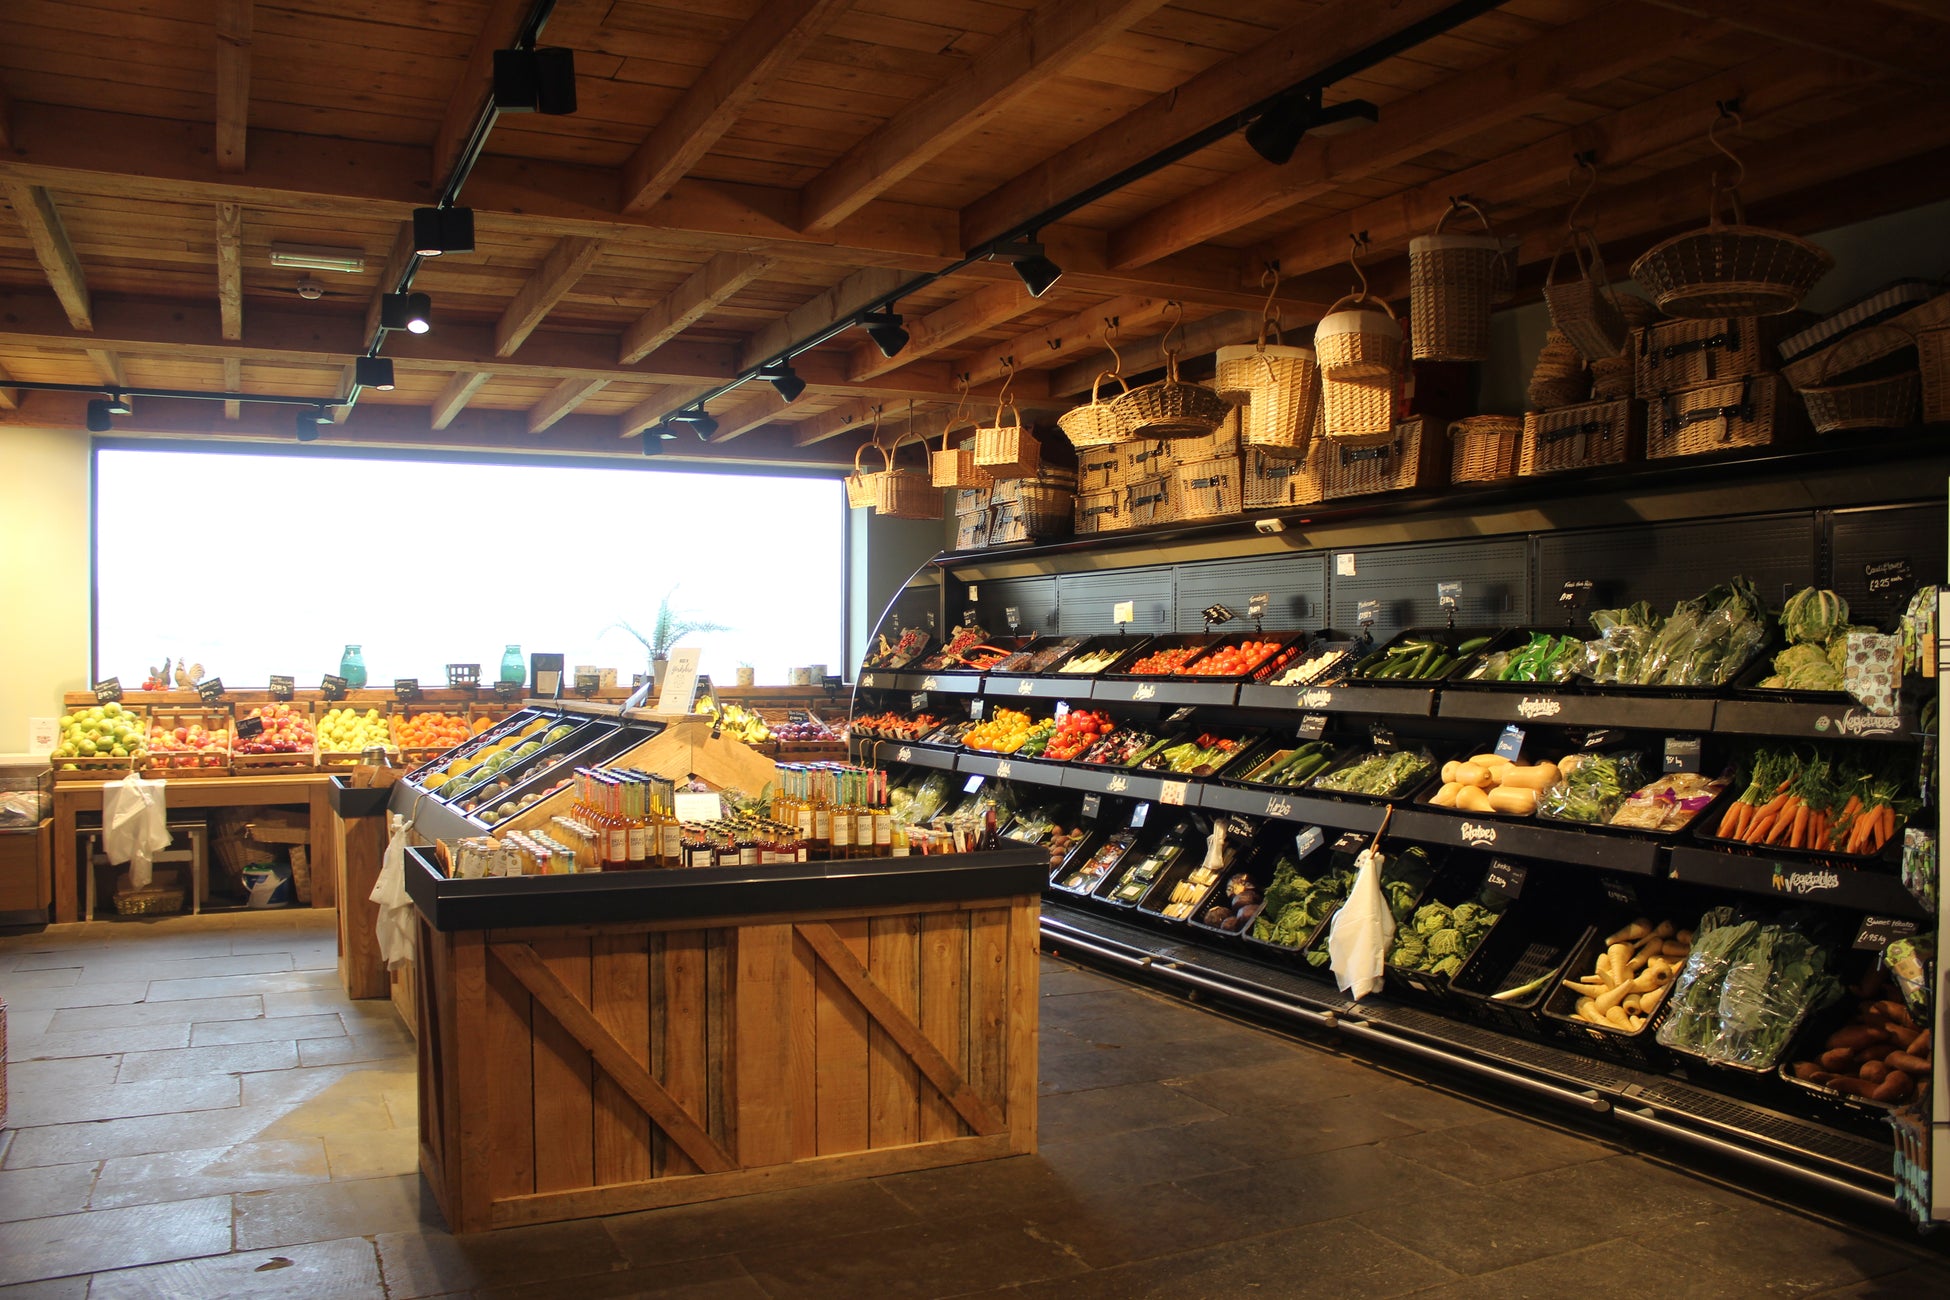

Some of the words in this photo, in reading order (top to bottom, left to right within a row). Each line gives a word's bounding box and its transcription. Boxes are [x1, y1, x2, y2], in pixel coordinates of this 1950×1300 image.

[1517, 697, 1561, 718] Vegetables
[1461, 822, 1497, 841] Potatoes
[1785, 871, 1839, 893] Vegetables
